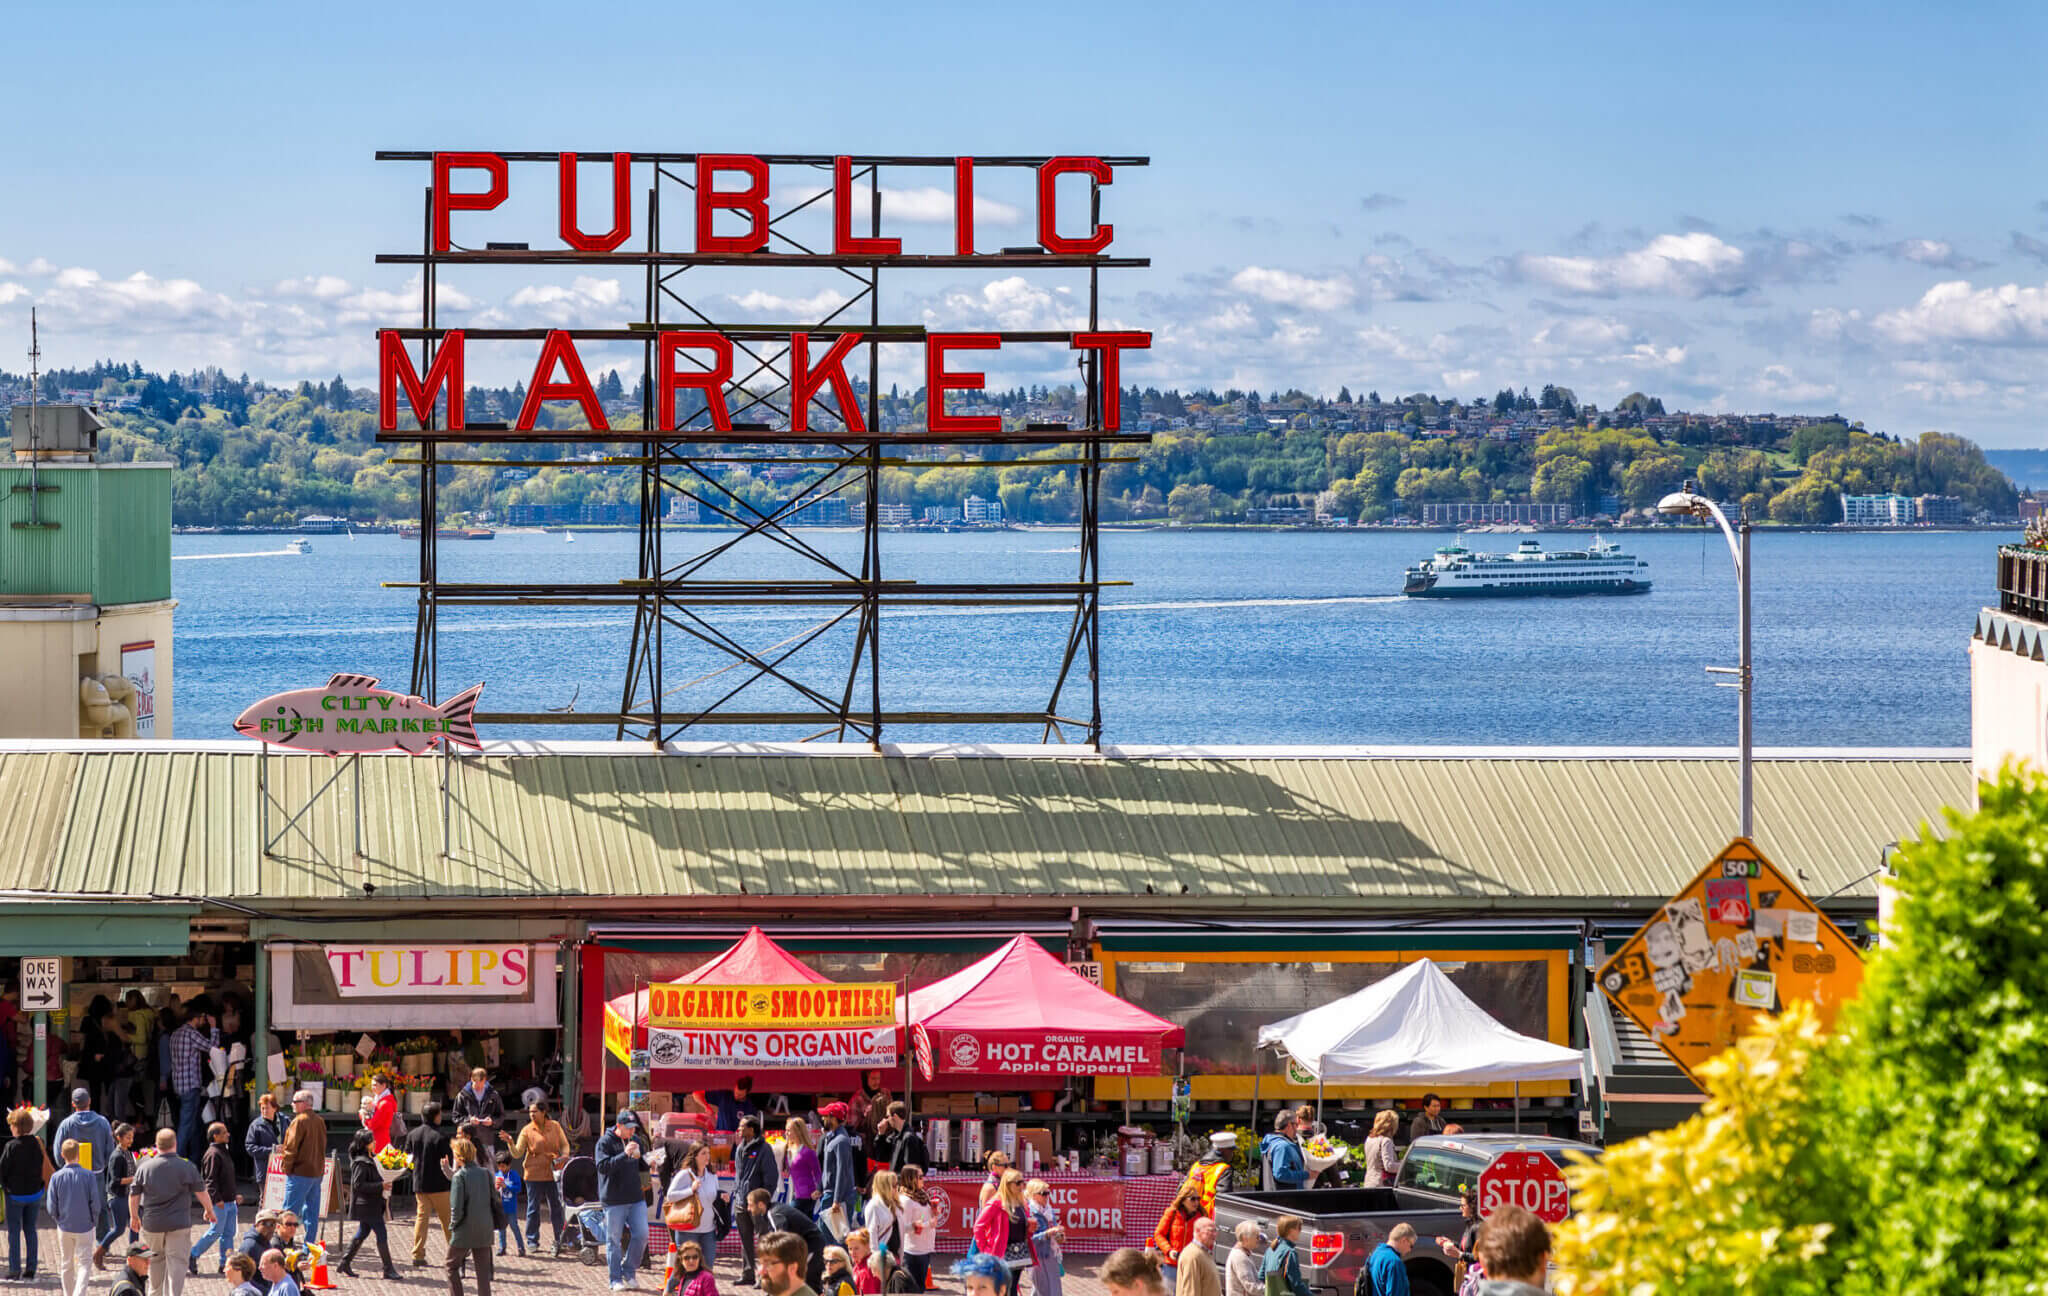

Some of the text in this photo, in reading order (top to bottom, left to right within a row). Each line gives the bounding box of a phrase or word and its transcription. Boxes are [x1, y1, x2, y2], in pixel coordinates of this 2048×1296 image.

[433, 151, 1113, 255] PUBLIC
[379, 329, 1152, 433] MARKET
[321, 695, 395, 711] CITY
[260, 717, 453, 734] FISH MARKET
[26, 962, 56, 975] ONE
[328, 948, 527, 988] TULIPS
[26, 977, 56, 989] WAY
[651, 989, 891, 1018] ORGANIC SMOOTHIES!
[683, 1032, 759, 1057] TINY'S
[1045, 1035, 1086, 1043] ORGANIC
[733, 1057, 754, 1065] Brand
[755, 1058, 781, 1067] Organic
[783, 1058, 798, 1066] Fruit
[806, 1058, 842, 1067] Vegetables
[883, 1056, 895, 1064] WA
[987, 1043, 1035, 1060] HOT
[1042, 1045, 1149, 1063] CARAMEL
[999, 1061, 1132, 1074] Apple Dippers!
[1485, 1179, 1566, 1212] STOP
[1067, 1208, 1123, 1229] CIDER
